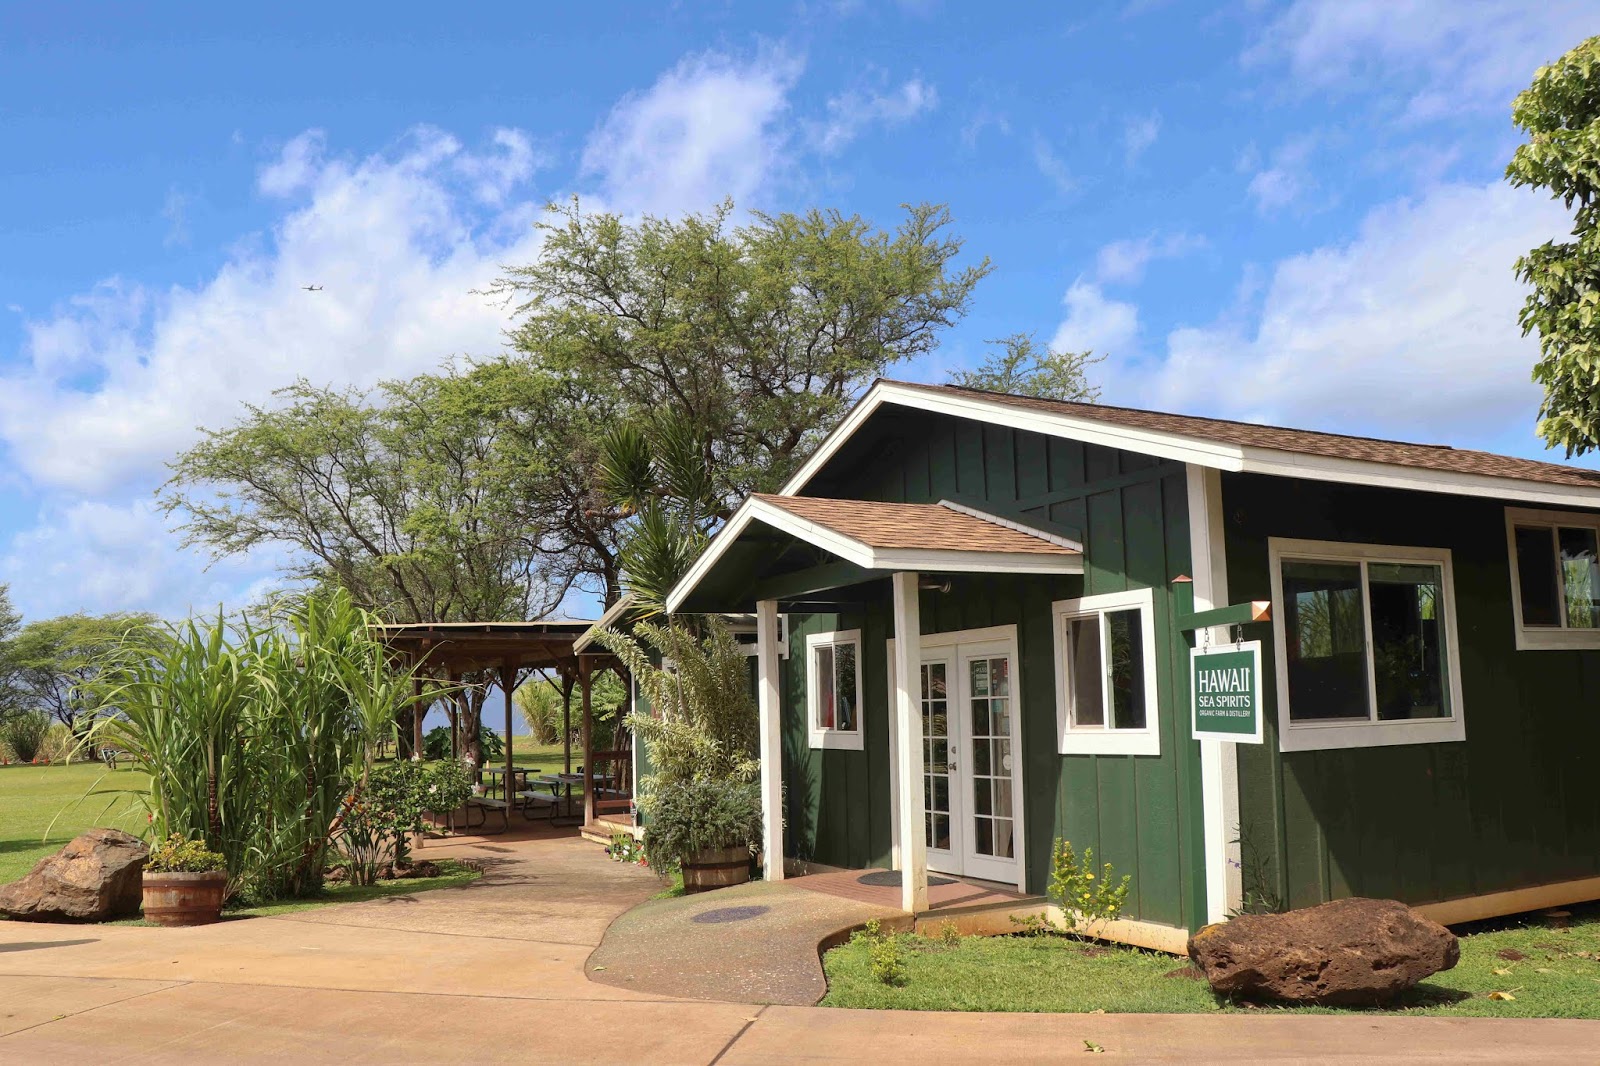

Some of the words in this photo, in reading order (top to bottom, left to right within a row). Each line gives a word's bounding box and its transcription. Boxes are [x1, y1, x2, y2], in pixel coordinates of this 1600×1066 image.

[1199, 667, 1250, 692] HAWAII
[1198, 695, 1215, 707] SEA
[1216, 695, 1250, 708] SPIRITS
